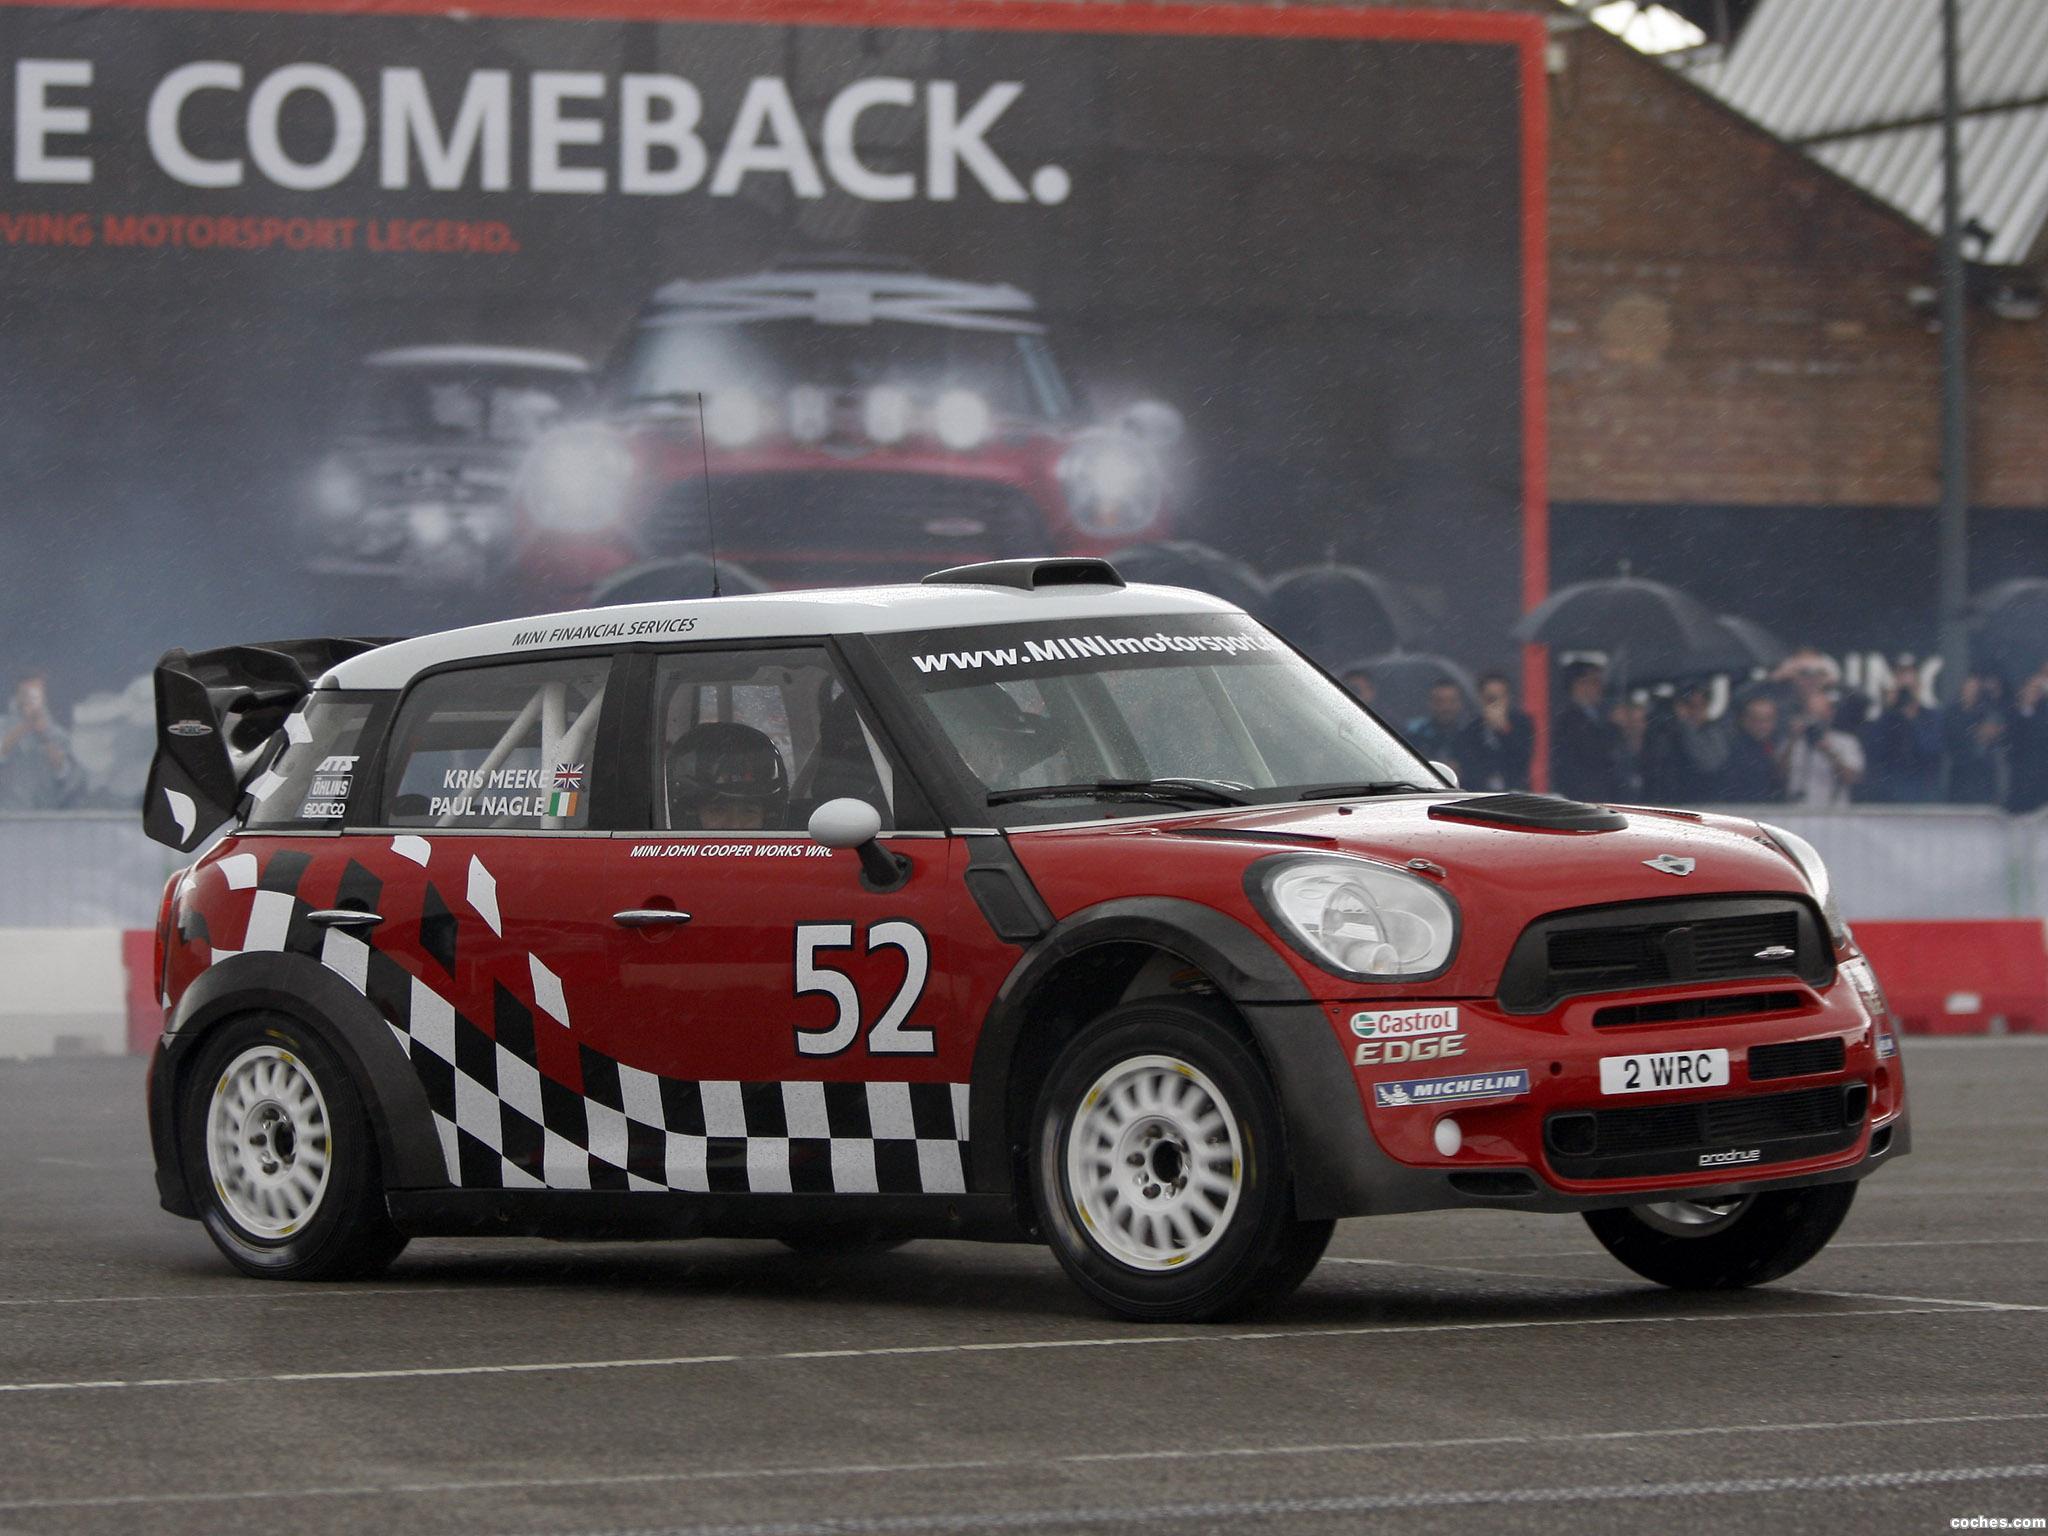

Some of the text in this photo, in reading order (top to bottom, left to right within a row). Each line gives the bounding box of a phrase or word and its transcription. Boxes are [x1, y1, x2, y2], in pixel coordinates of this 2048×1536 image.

[14, 60, 1071, 204] E COMEBACK.
[103, 213, 358, 250] MOTORSPORT
[366, 218, 519, 254] LEGEND.
[512, 618, 698, 646] MINI FINANCIAL SERVICES
[314, 755, 360, 771] ATS
[443, 769, 551, 789] KRIS MEEKE
[302, 802, 346, 819] sparco
[429, 796, 546, 816] PAUL NAGLE
[630, 845, 660, 857] MINI
[661, 845, 700, 857] JOHN
[700, 845, 752, 857] COOPER
[754, 845, 804, 857] WORKS
[793, 917, 938, 1059] 52
[1378, 1010, 1453, 1034] Castrol
[1354, 1033, 1468, 1066] EDGE
[1624, 1053, 1712, 1089] 2 WRC
[1413, 1075, 1521, 1097] MICHELIN
